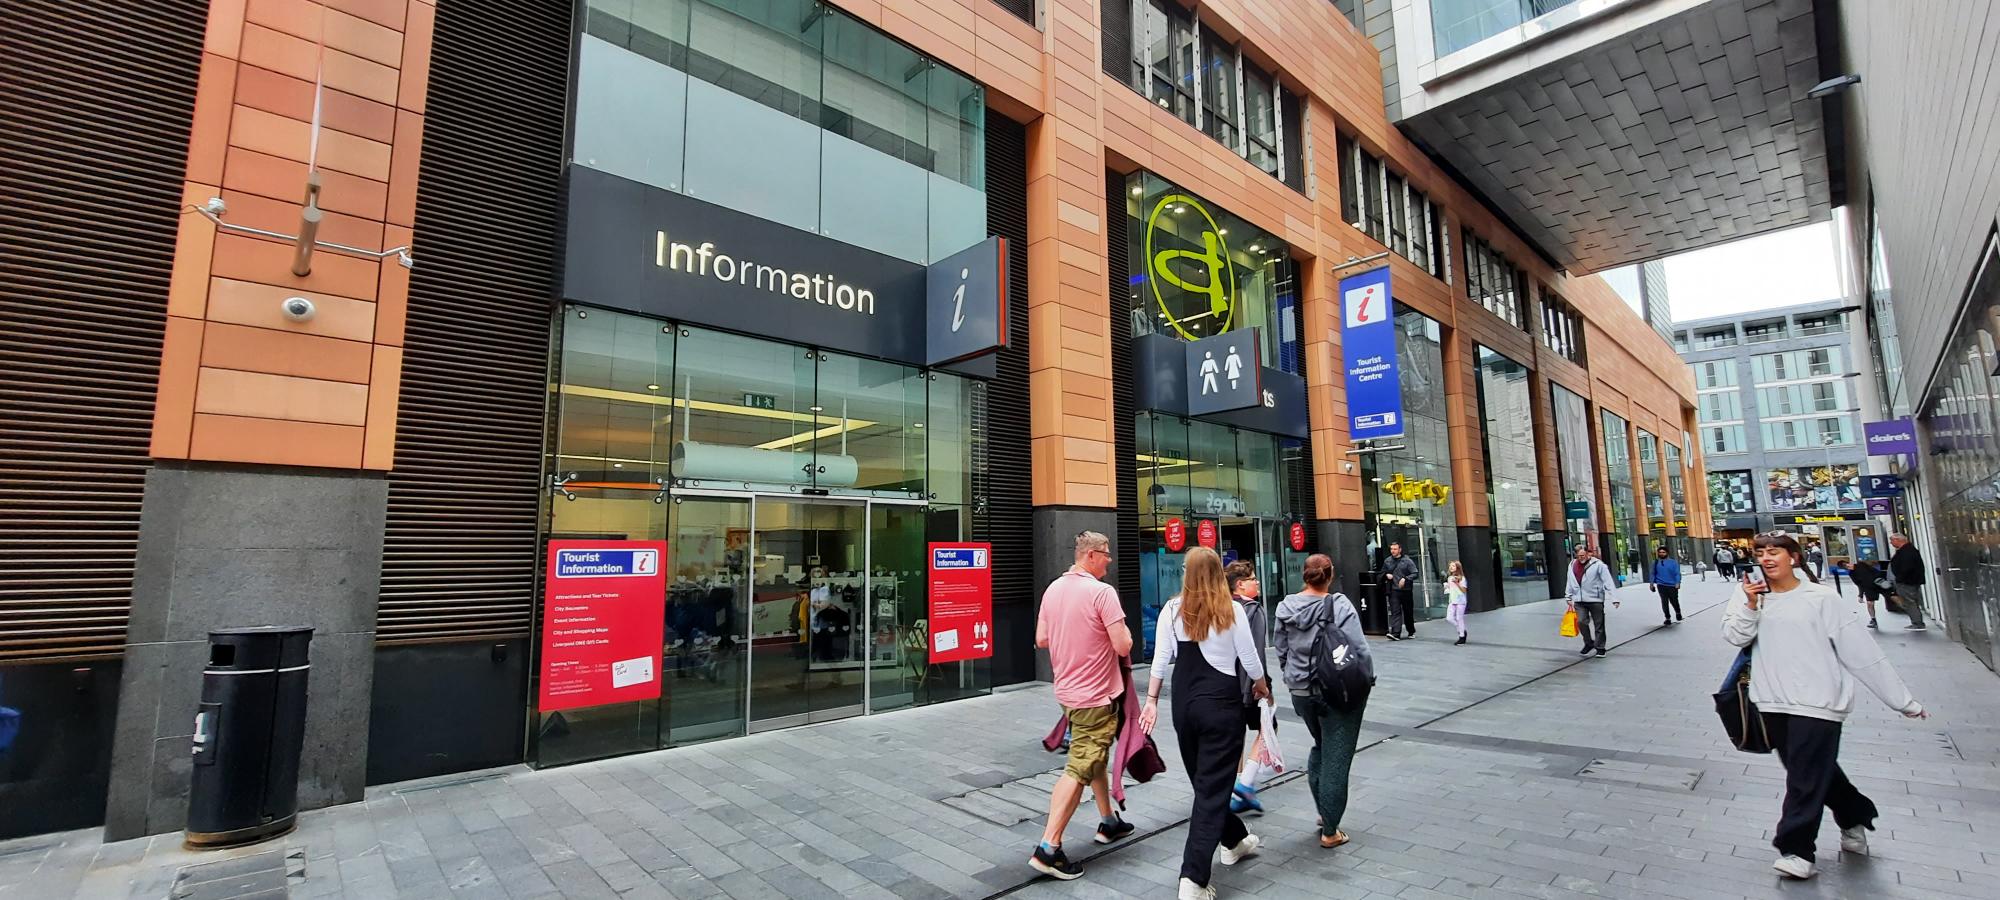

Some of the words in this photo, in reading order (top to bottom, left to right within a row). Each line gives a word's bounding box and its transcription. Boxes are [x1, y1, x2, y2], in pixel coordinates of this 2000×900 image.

[655, 230, 875, 315] Information
[1357, 355, 1382, 366] Tourist
[1349, 363, 1391, 375] Information
[1358, 373, 1383, 382] Centre
[1870, 432, 1911, 443] claire's
[1871, 478, 1881, 489] P
[562, 552, 600, 563] Tourist
[936, 551, 956, 559] Tourist
[562, 564, 623, 574] Information
